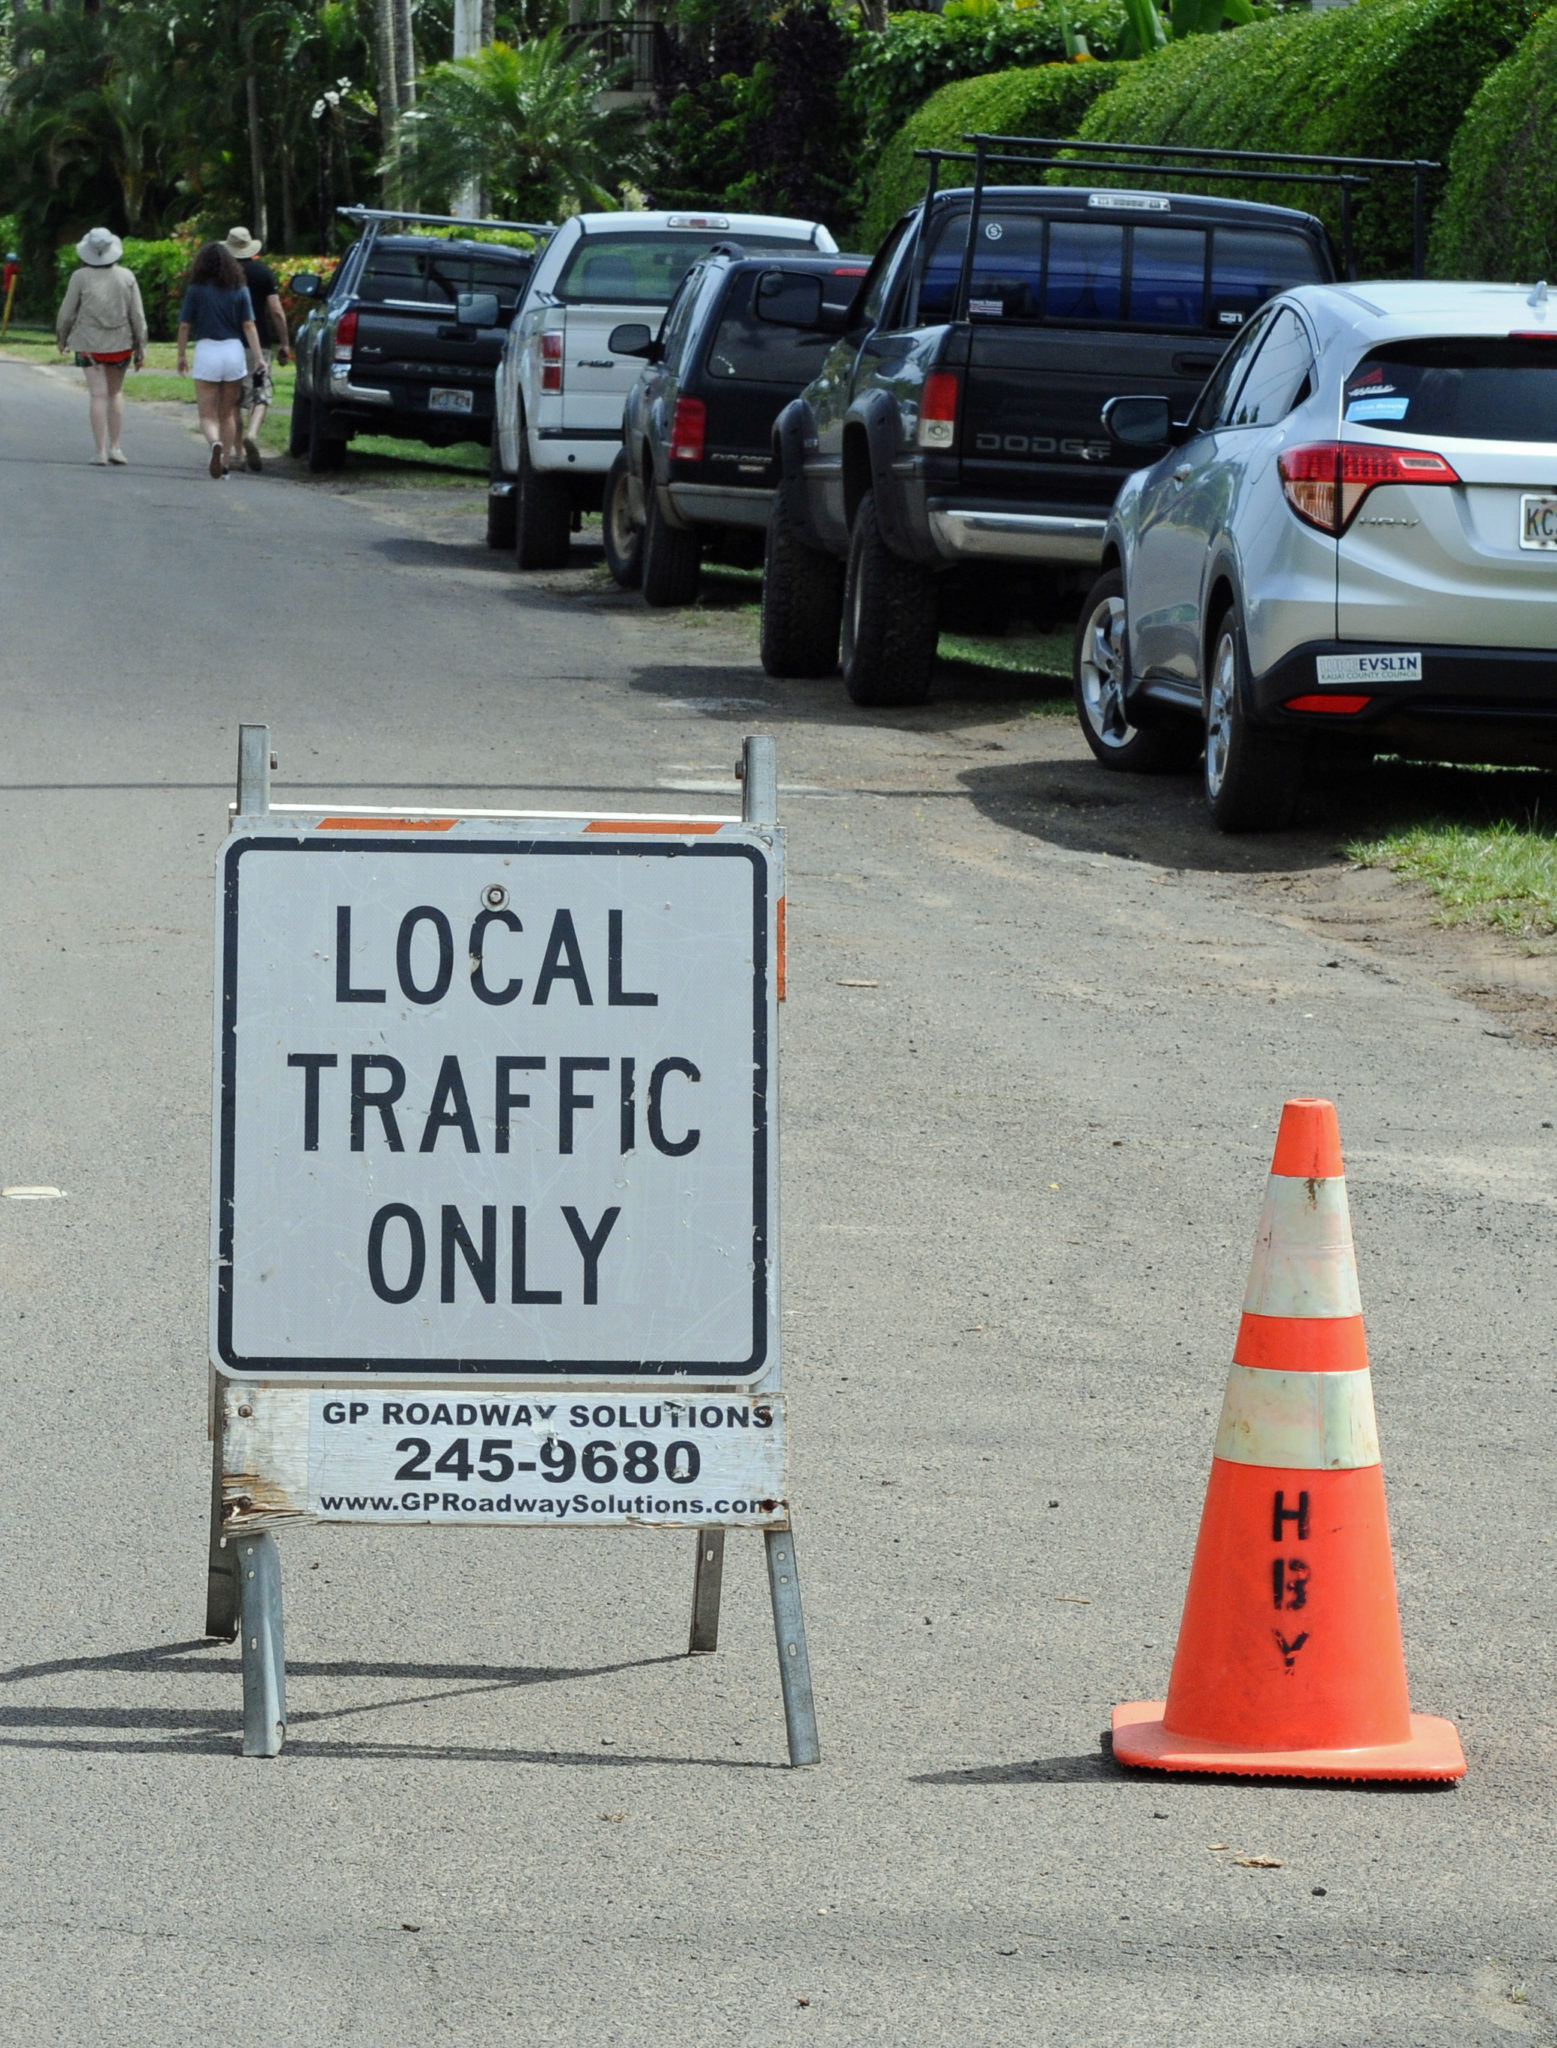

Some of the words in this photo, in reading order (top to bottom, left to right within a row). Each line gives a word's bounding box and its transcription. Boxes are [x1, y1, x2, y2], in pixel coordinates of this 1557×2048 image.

[976, 433, 1112, 457] DODGE
[1527, 507, 1557, 536] KC
[1347, 672, 1379, 680] COUNTY
[1359, 657, 1417, 671] EVSLIN
[335, 905, 658, 1006] LOCAL
[287, 1053, 701, 1157] TRAFFIC
[367, 1202, 622, 1305] ONLY
[322, 1402, 369, 1425] GP
[382, 1403, 557, 1427] ROADWAY
[568, 1401, 773, 1429] SOLUTIONS
[393, 1436, 701, 1485] 245-9680
